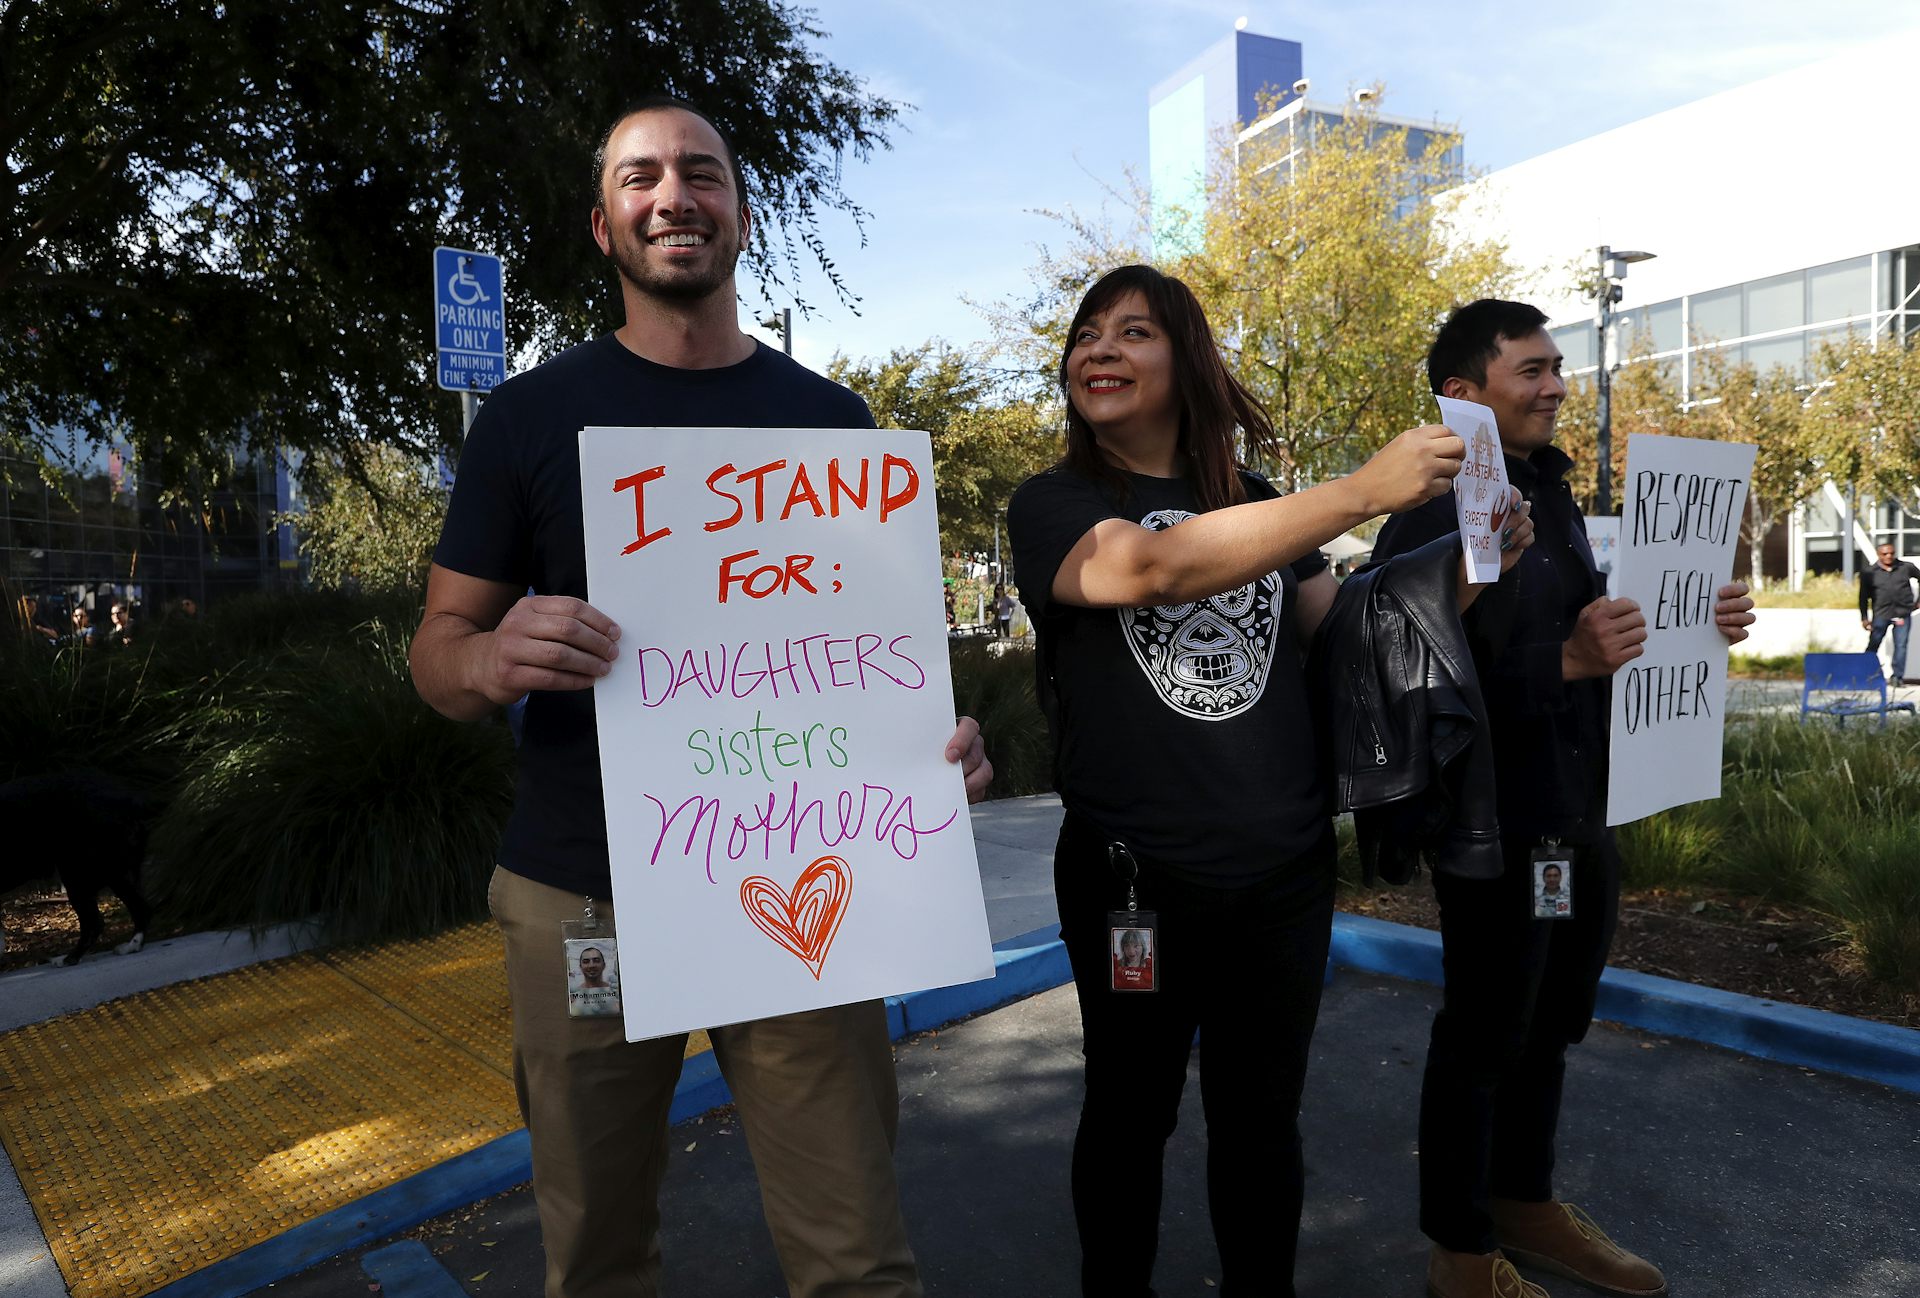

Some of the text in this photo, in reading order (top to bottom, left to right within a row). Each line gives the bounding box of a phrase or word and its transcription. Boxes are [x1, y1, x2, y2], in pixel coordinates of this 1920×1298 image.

[440, 304, 500, 330] PARKING
[453, 327, 490, 350] ONLY
[450, 354, 493, 370] MINIMUM
[444, 370, 500, 387] FINE $250
[1465, 461, 1500, 482] EXISTENCE
[612, 453, 920, 556] I STAND
[1475, 488, 1487, 503] OR
[1632, 470, 1742, 547] RESPECT
[1464, 509, 1488, 527] EXPECT
[1655, 569, 1713, 630] EACH
[638, 633, 926, 708] DAUGHTERS
[1625, 660, 1711, 735] OTHER
[687, 710, 849, 783] sisters
